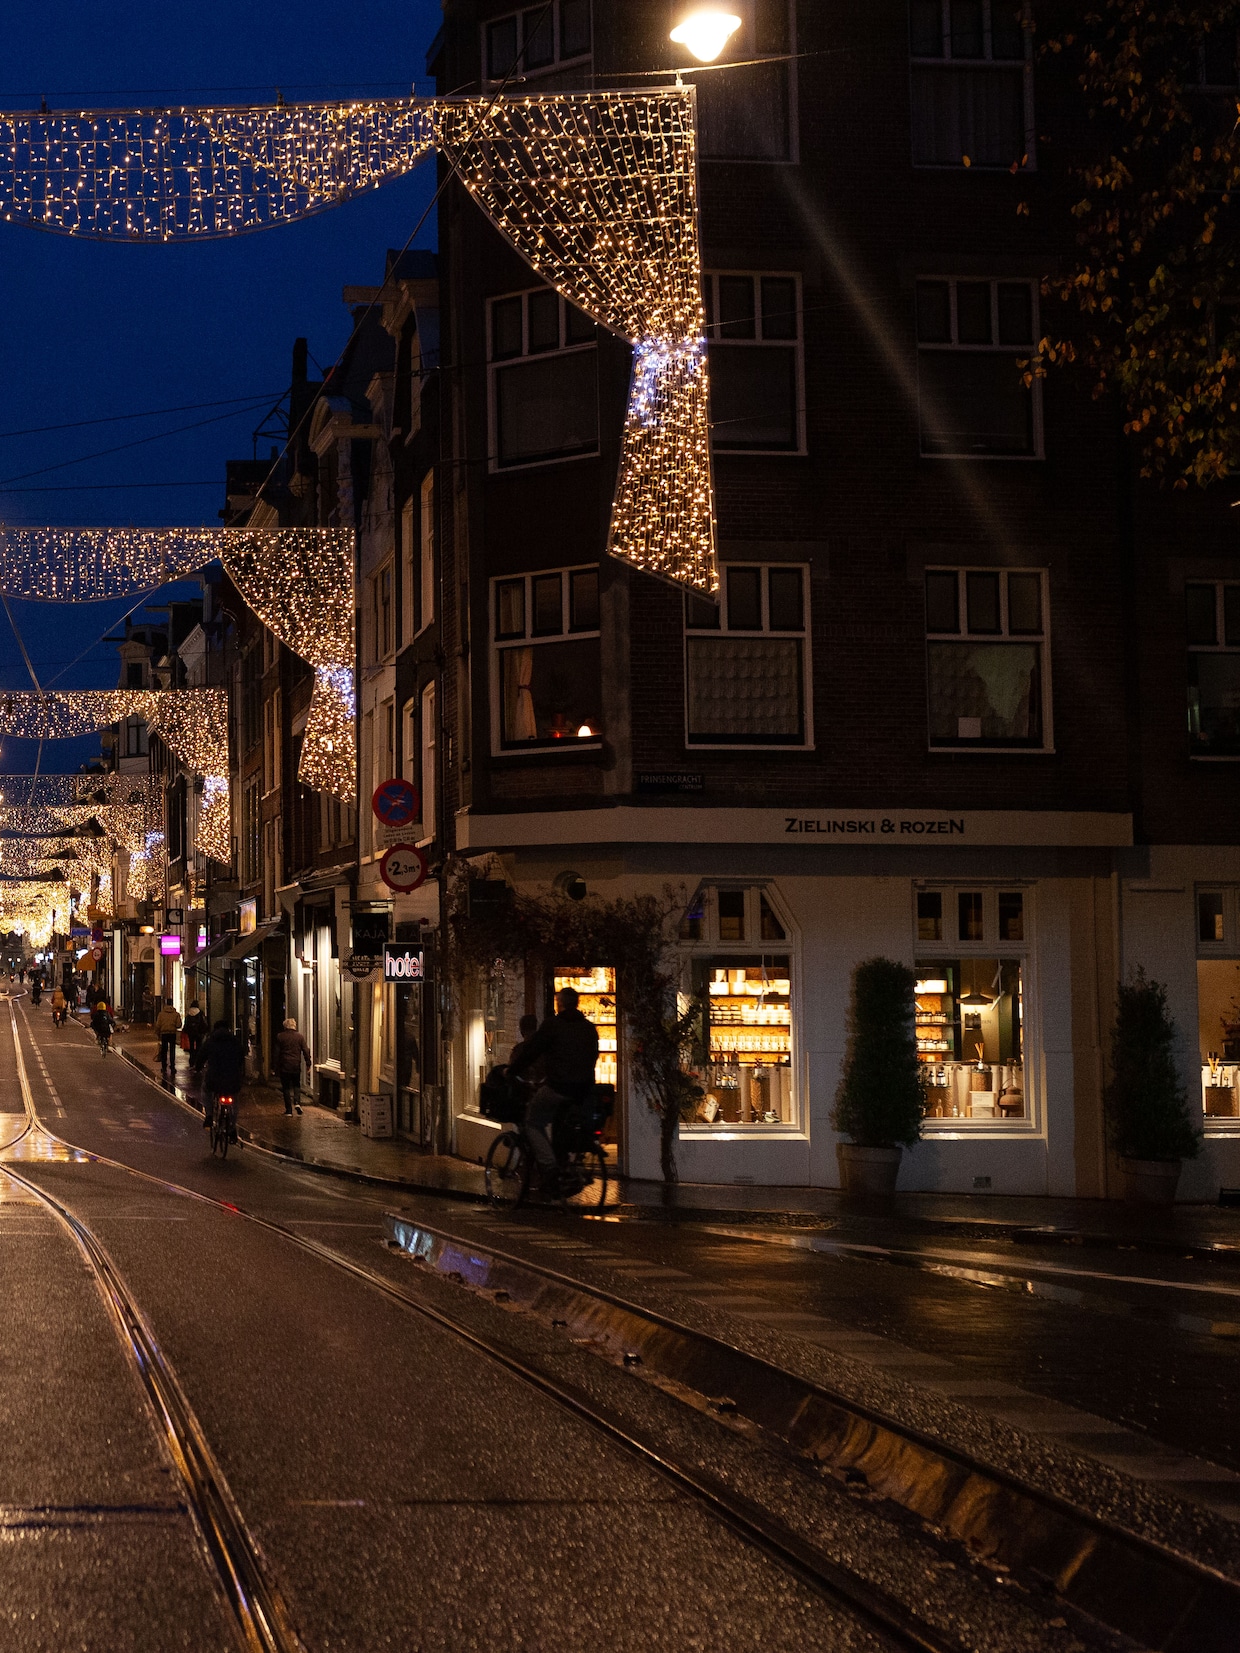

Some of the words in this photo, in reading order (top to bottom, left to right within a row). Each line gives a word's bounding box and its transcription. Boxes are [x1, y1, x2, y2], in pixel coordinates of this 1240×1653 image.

[640, 775, 703, 784] PRINSENGRACHT
[785, 818, 875, 833] ZIELINSKI
[880, 818, 895, 834] &
[900, 819, 965, 834] ROZEN
[355, 928, 387, 939] KAJA
[385, 951, 424, 977] hotel
